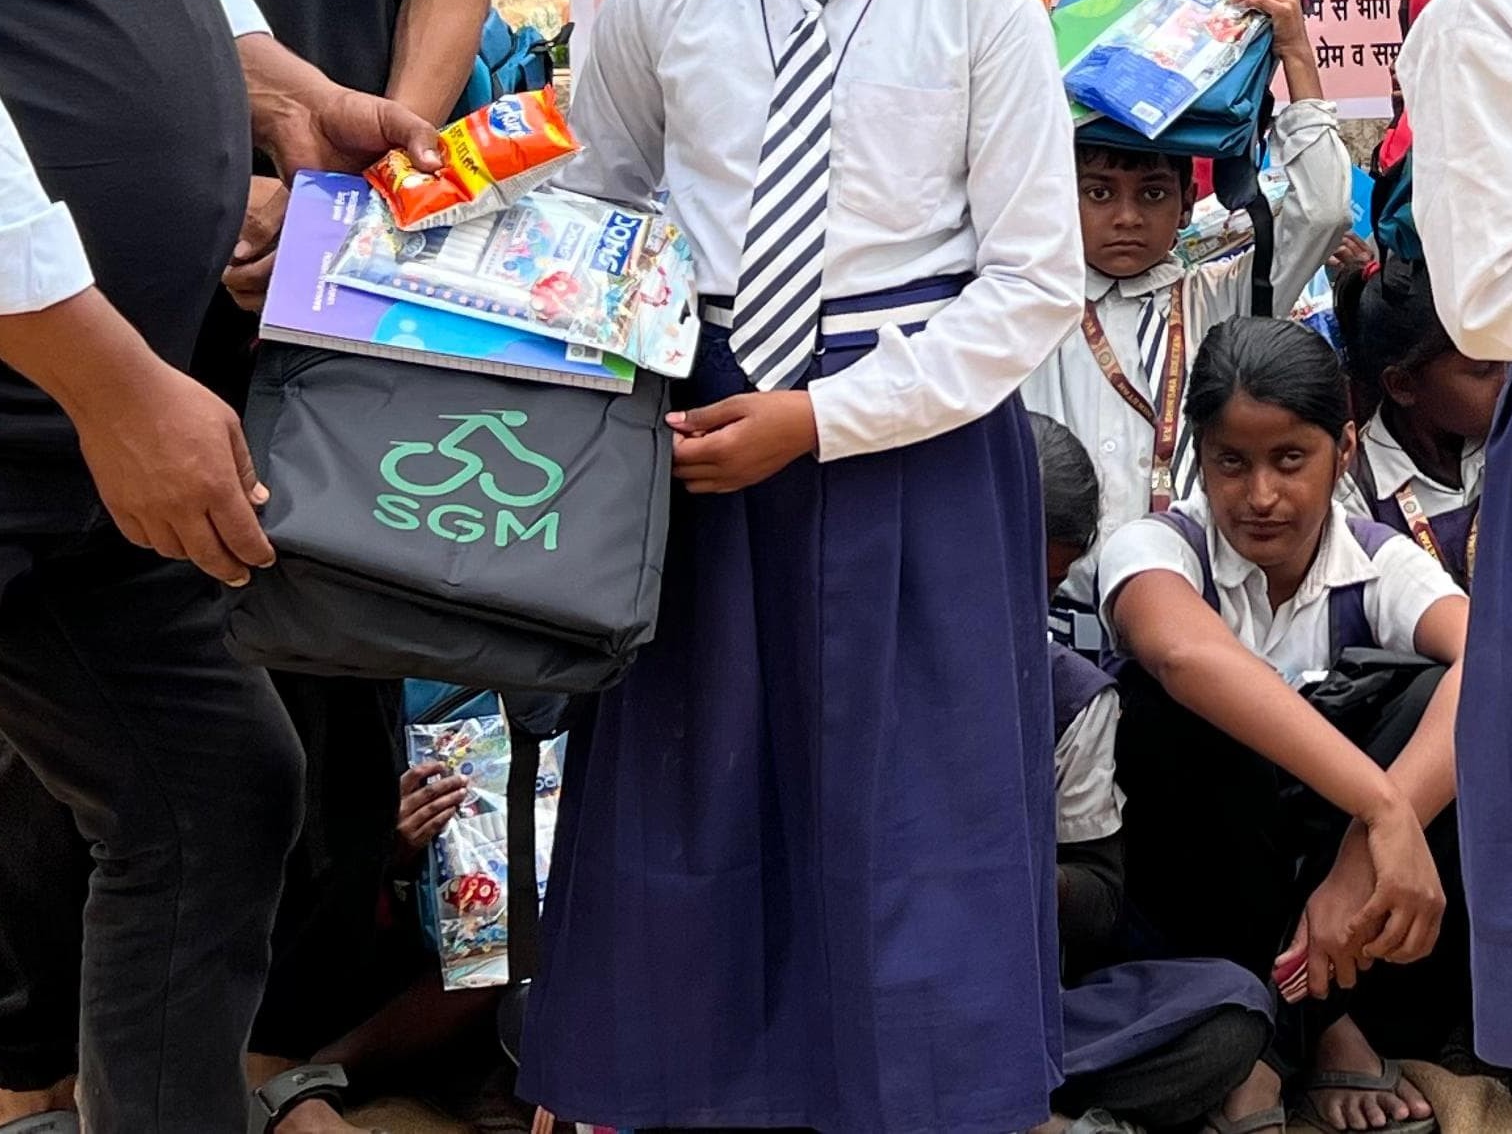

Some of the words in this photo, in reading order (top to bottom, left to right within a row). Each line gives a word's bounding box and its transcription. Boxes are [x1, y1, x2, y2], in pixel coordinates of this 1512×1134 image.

[1316, 36, 1344, 68] प्रेम
[1351, 44, 1364, 67] व
[1370, 42, 1402, 66] सम
[593, 212, 643, 275] DOMS
[372, 493, 561, 551] SGM
